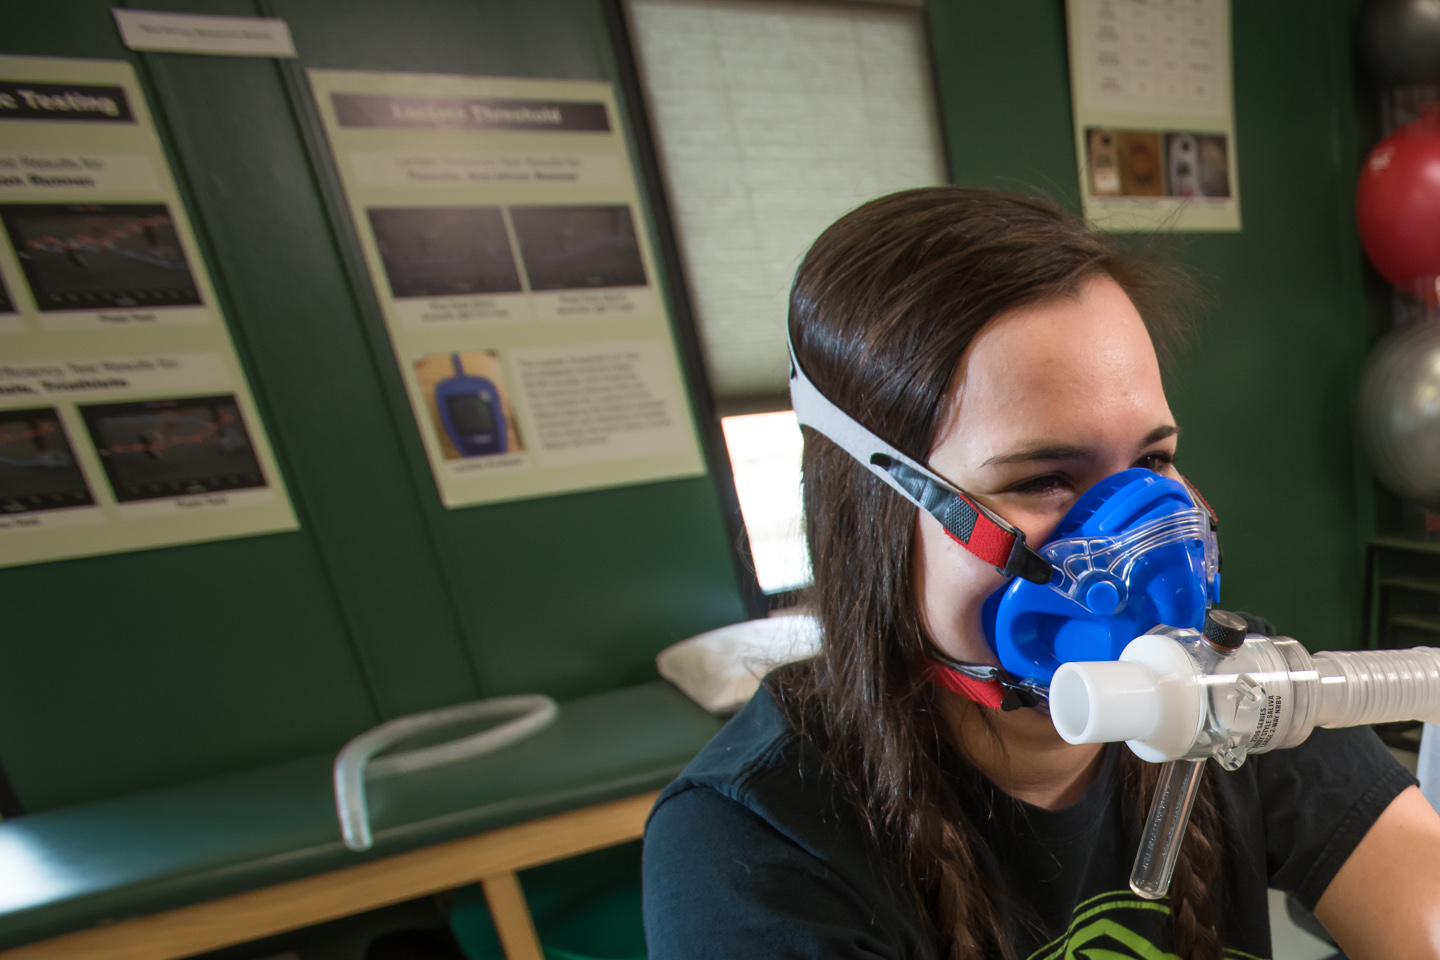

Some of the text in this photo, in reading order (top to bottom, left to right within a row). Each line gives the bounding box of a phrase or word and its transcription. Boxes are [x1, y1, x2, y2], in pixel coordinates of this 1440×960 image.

[15, 88, 120, 117] Testing
[1257, 707, 1266, 729] SERIES
[1261, 720, 1272, 736] STYLE
